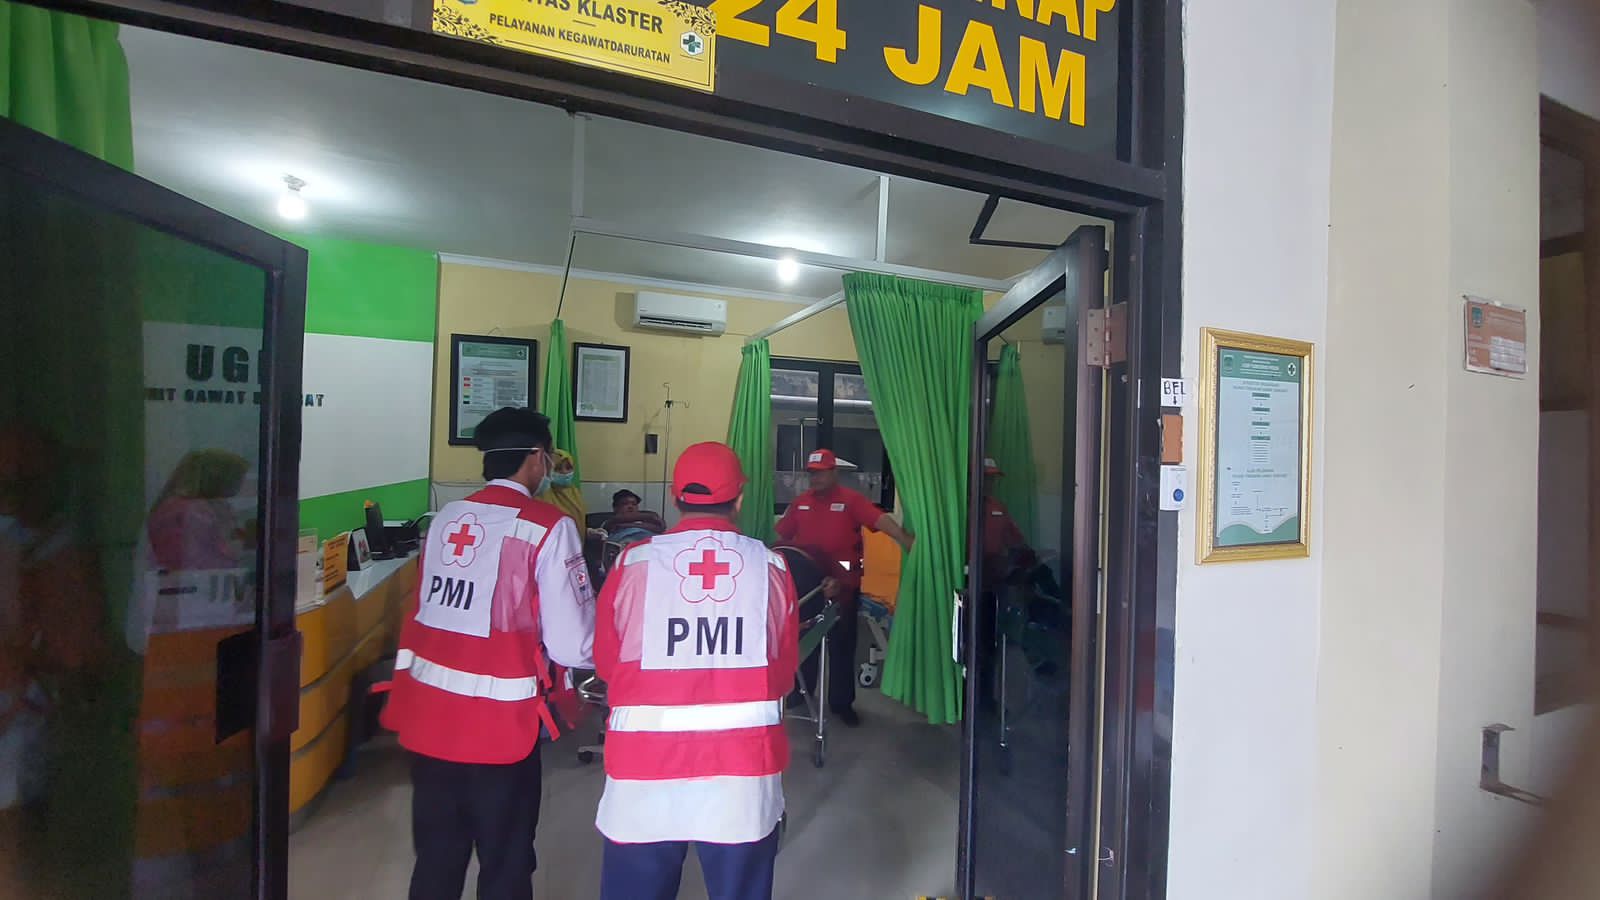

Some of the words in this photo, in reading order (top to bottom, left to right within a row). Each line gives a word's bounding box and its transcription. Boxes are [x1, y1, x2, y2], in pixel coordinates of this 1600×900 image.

[578, 0, 663, 34] KLASTER
[489, 13, 555, 38] PELAYANAN
[558, 28, 671, 64] KEGAWATDARURATAN
[709, 0, 846, 64] 24
[883, 5, 1086, 127] JAM
[186, 343, 263, 383] UG
[184, 388, 247, 404] GAWAT
[426, 575, 474, 610] PMI
[666, 617, 744, 656] PMI
